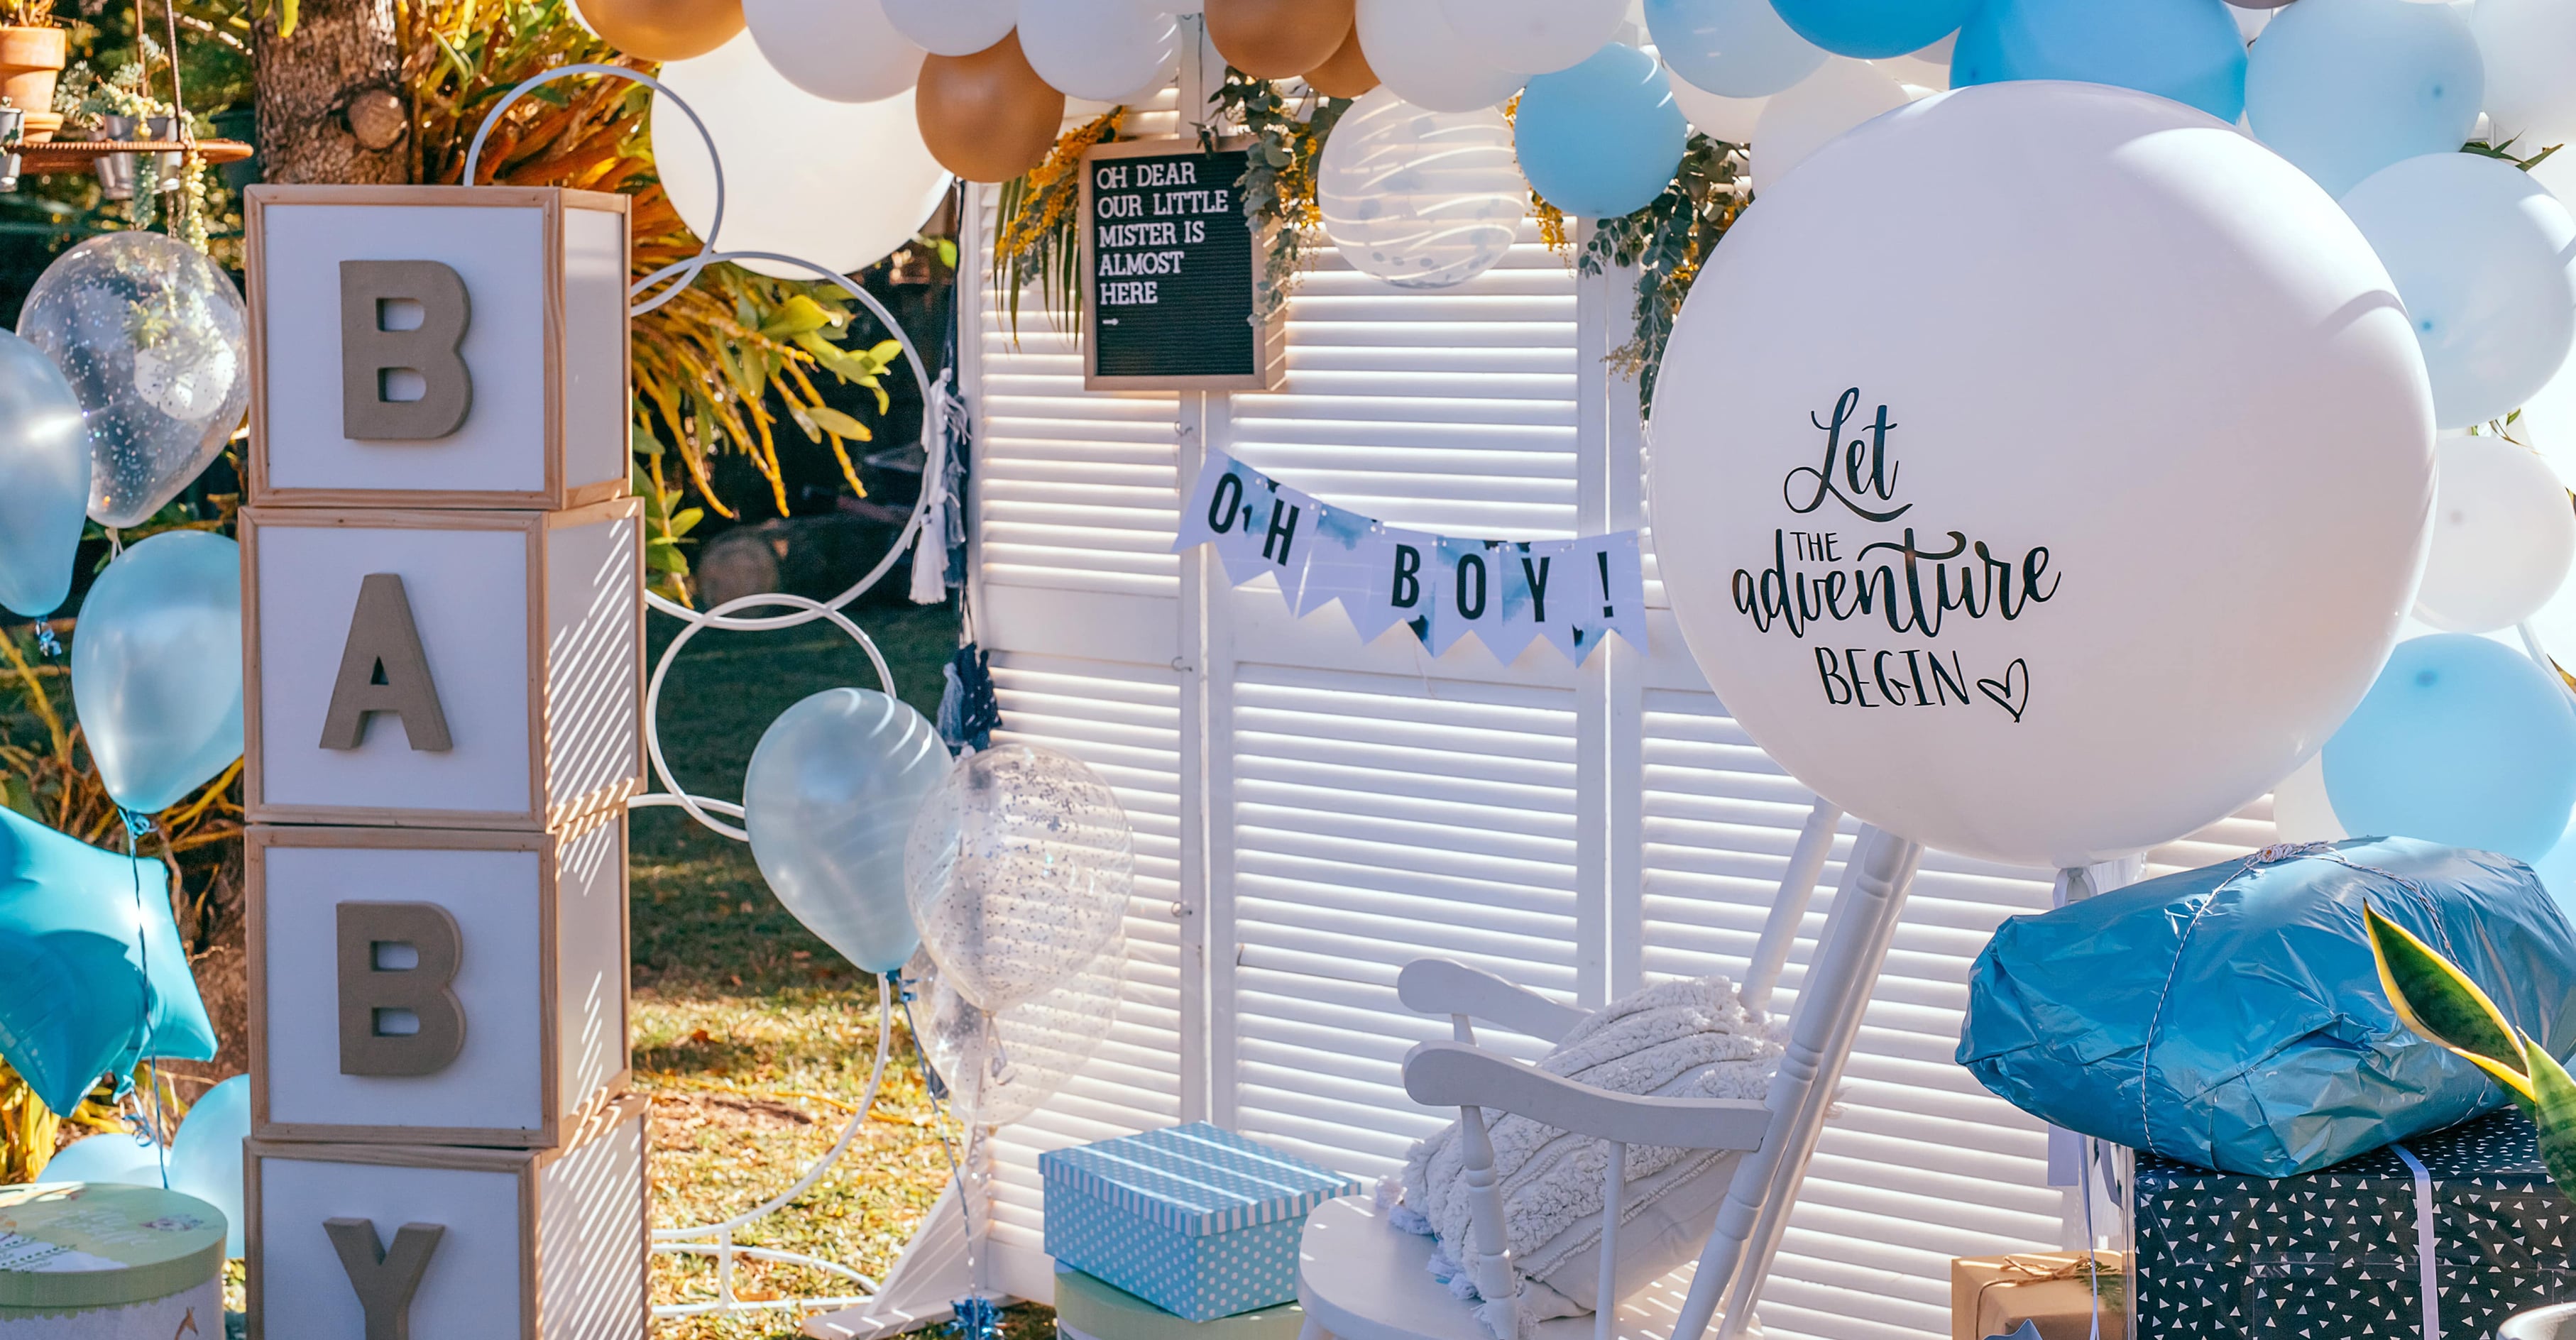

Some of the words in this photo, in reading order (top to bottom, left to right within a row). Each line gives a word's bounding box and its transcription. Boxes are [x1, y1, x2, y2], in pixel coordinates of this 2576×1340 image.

[1097, 166, 1127, 190] OH
[1136, 162, 1197, 187] DEAR
[1097, 194, 1144, 219] OUR
[1153, 190, 1229, 215] LITTLE
[1099, 222, 1178, 248] MISTER
[1184, 221, 1205, 243] IS
[1099, 251, 1185, 276] ALMOST
[1100, 281, 1158, 305] HERE
[1783, 387, 1913, 523] Let
[1208, 472, 1300, 566] OH
[1789, 532, 1843, 562] THE
[1732, 527, 2061, 639] adventure
[1814, 647, 1971, 708] BEGIN
